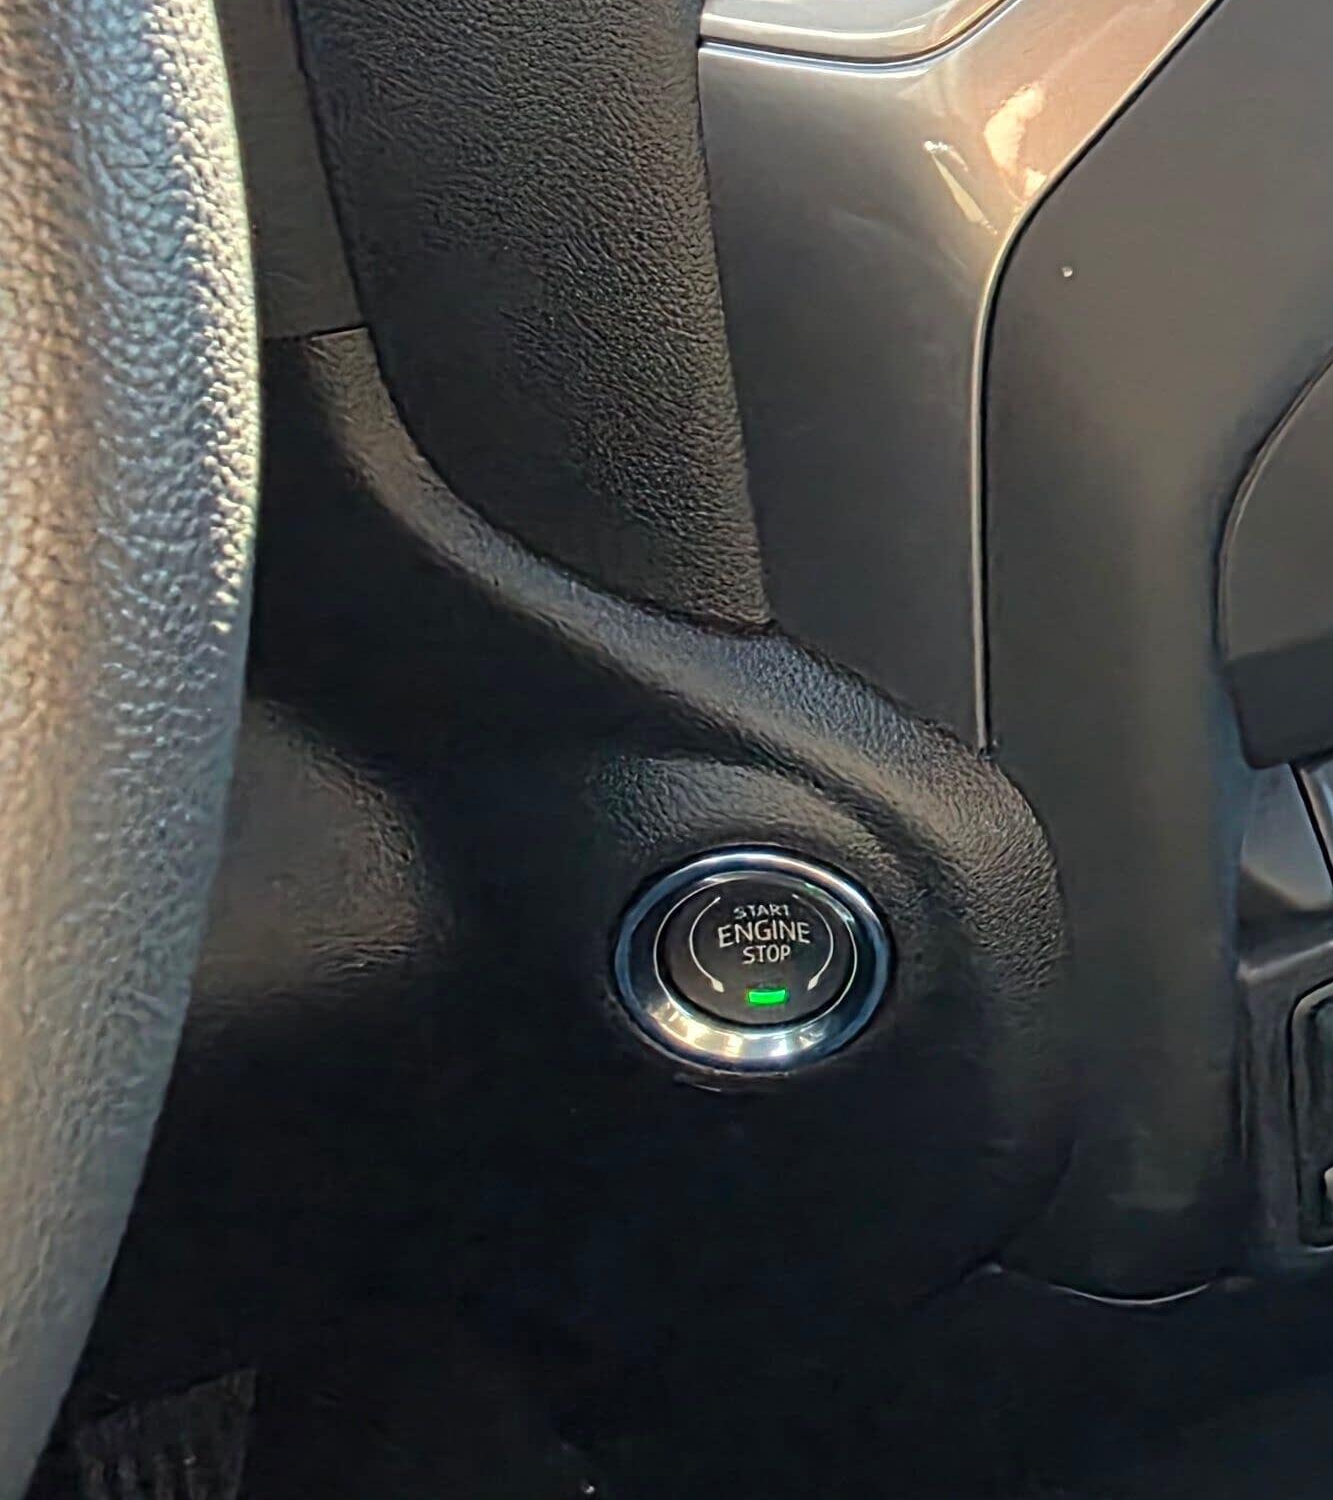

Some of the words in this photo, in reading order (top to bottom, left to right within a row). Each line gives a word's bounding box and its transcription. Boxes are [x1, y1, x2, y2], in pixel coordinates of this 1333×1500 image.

[733, 904, 790, 920] START
[717, 919, 811, 948] ENGINE
[742, 944, 792, 965] STOP
